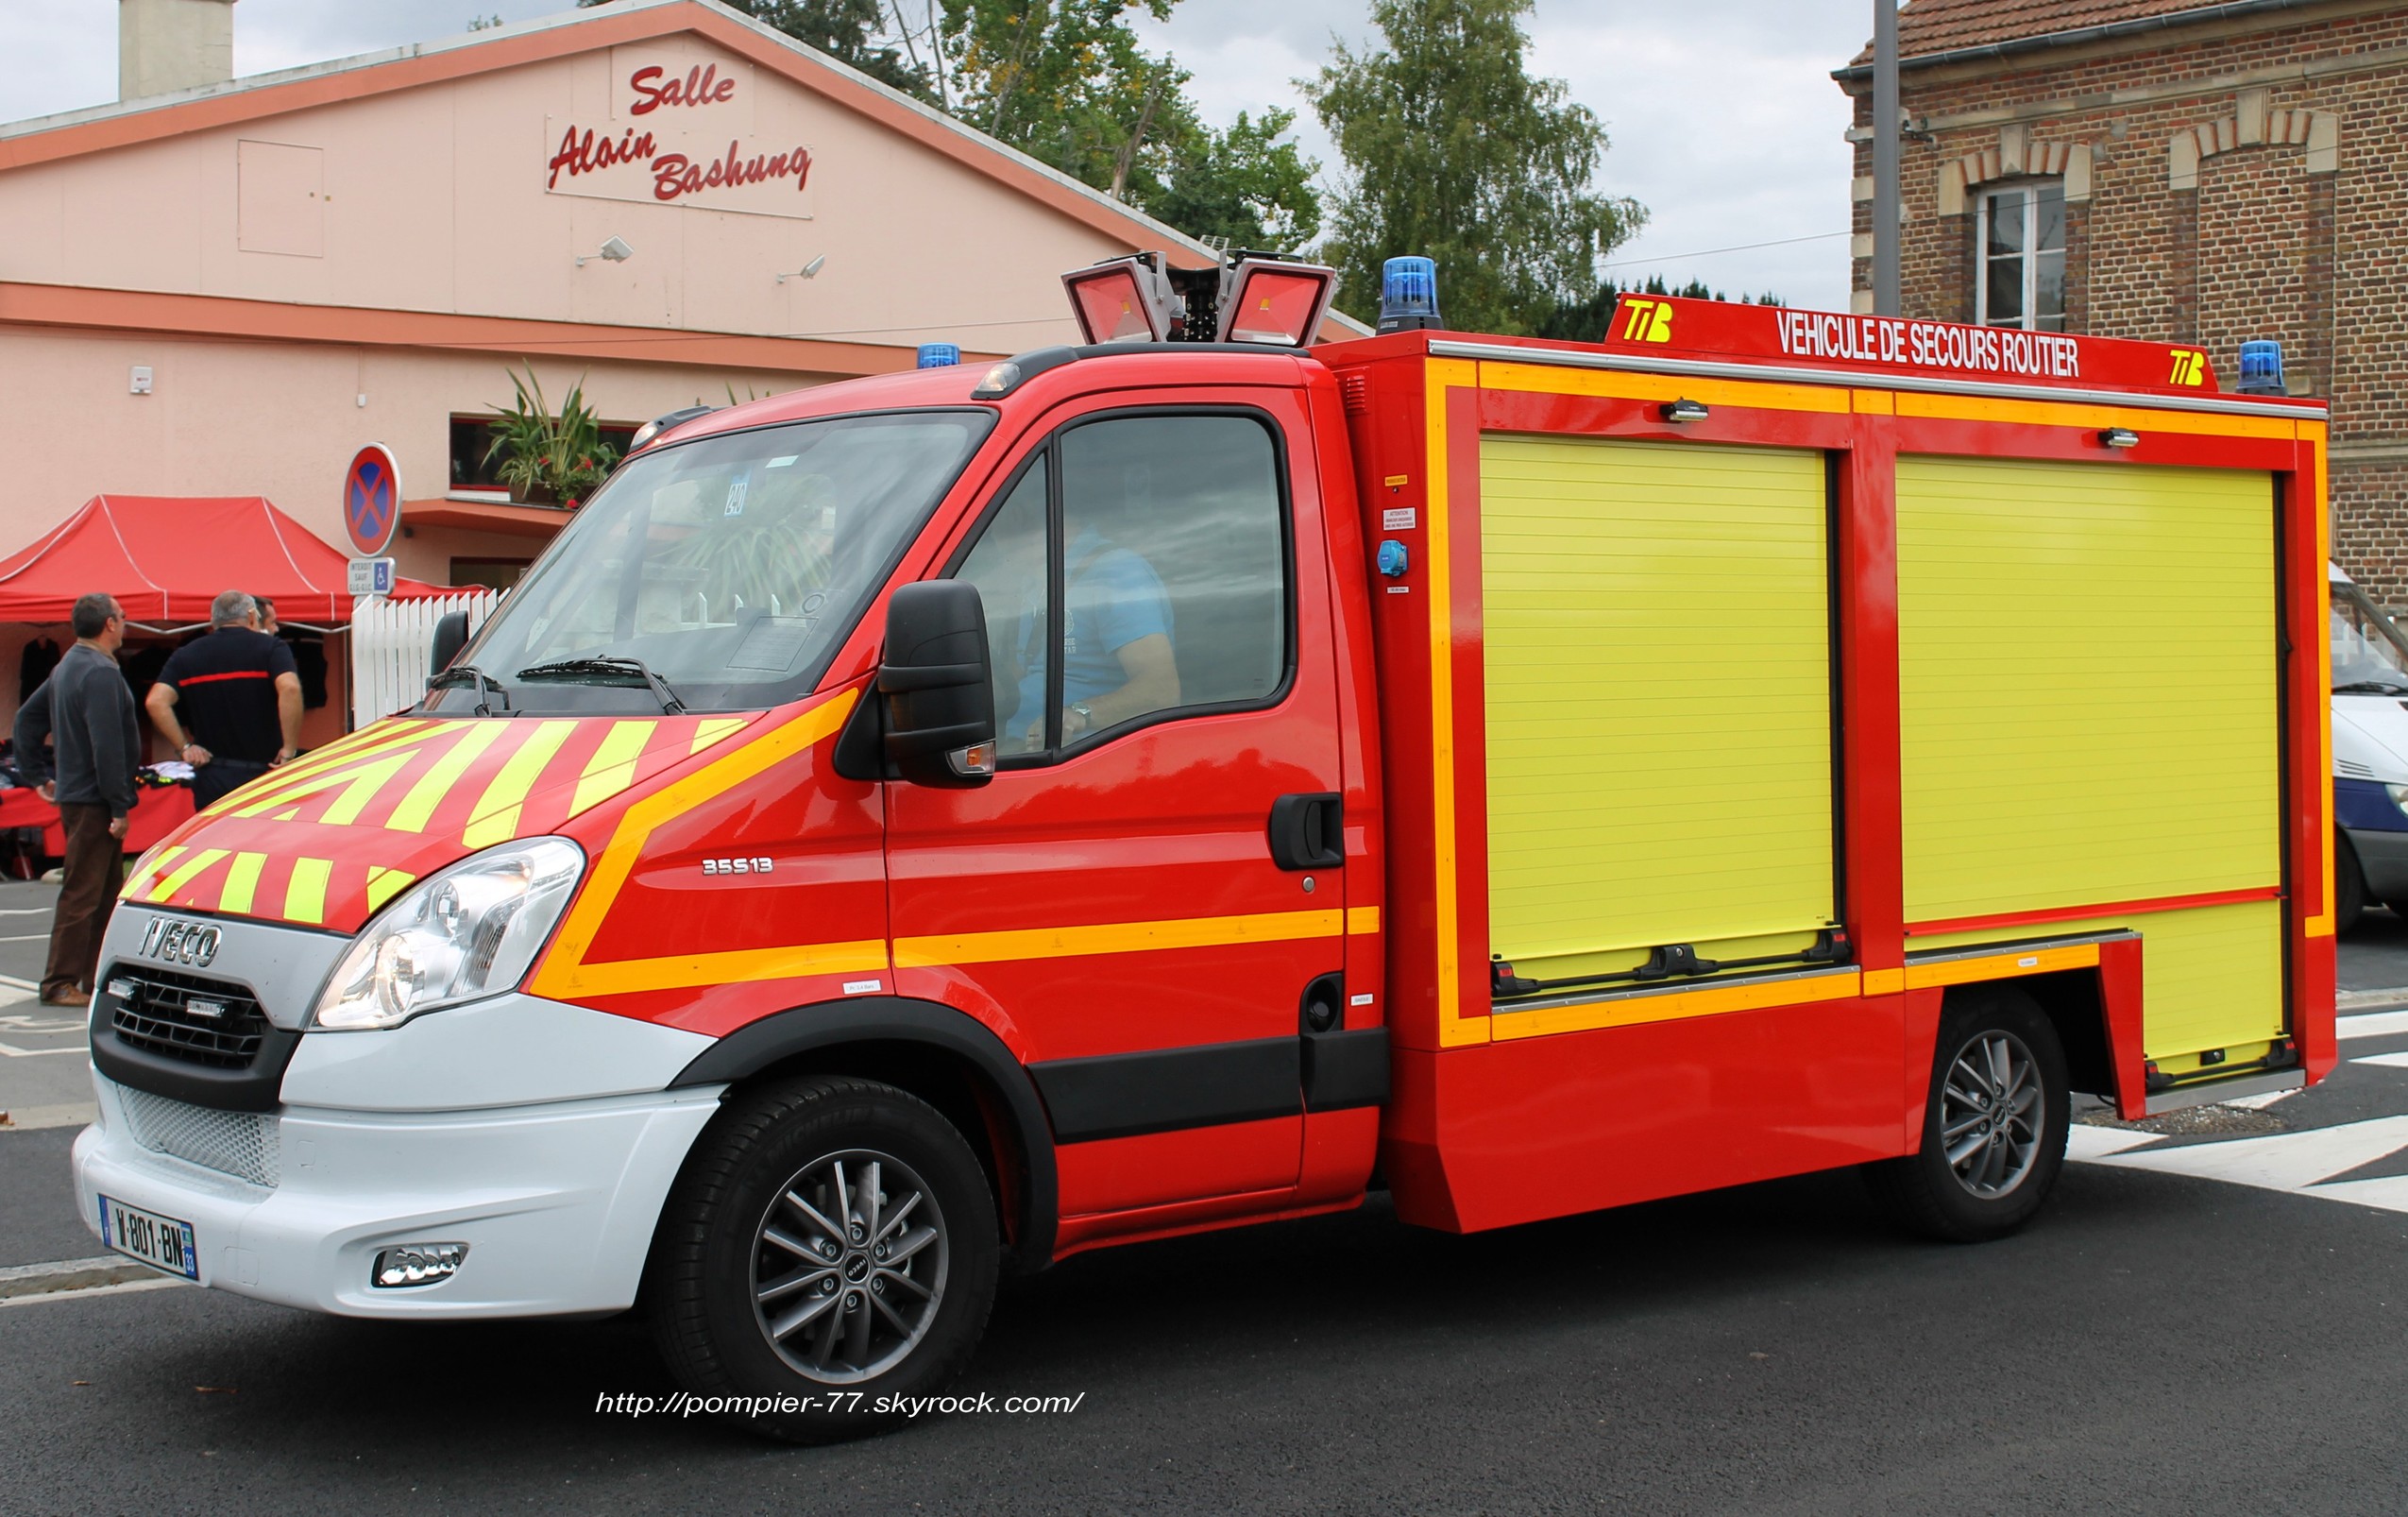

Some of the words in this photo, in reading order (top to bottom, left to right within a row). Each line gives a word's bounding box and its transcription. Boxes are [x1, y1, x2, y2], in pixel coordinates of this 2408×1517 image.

[630, 62, 735, 115] Salle
[549, 125, 656, 190] Alain
[651, 139, 813, 200] Bashung
[1776, 310, 1877, 361] VEHICULE
[1879, 319, 1908, 363] DE
[1909, 322, 2000, 371] SECOURS
[2002, 332, 2079, 378] ROUTIER
[355, 572, 368, 582] SAUF
[702, 857, 773, 876] 35S13
[137, 916, 223, 967] IVECO
[848, 1258, 867, 1277] IVECO
